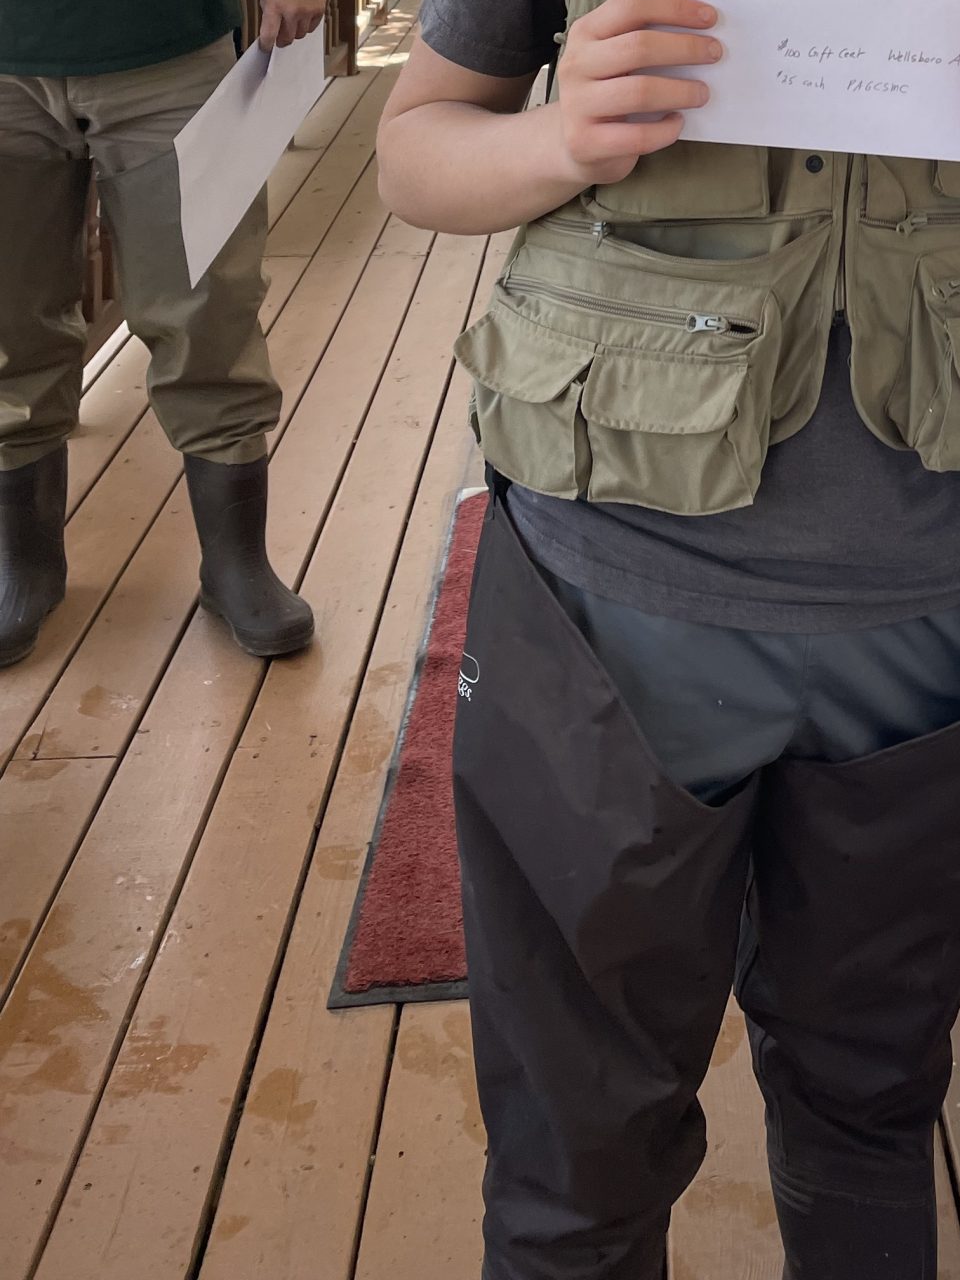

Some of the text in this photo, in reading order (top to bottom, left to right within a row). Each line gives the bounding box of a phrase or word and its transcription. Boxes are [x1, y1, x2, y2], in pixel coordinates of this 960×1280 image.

[808, 46, 834, 63] Gift
[888, 49, 942, 64] Wellsboro
[847, 79, 910, 94] PAGCSMC
